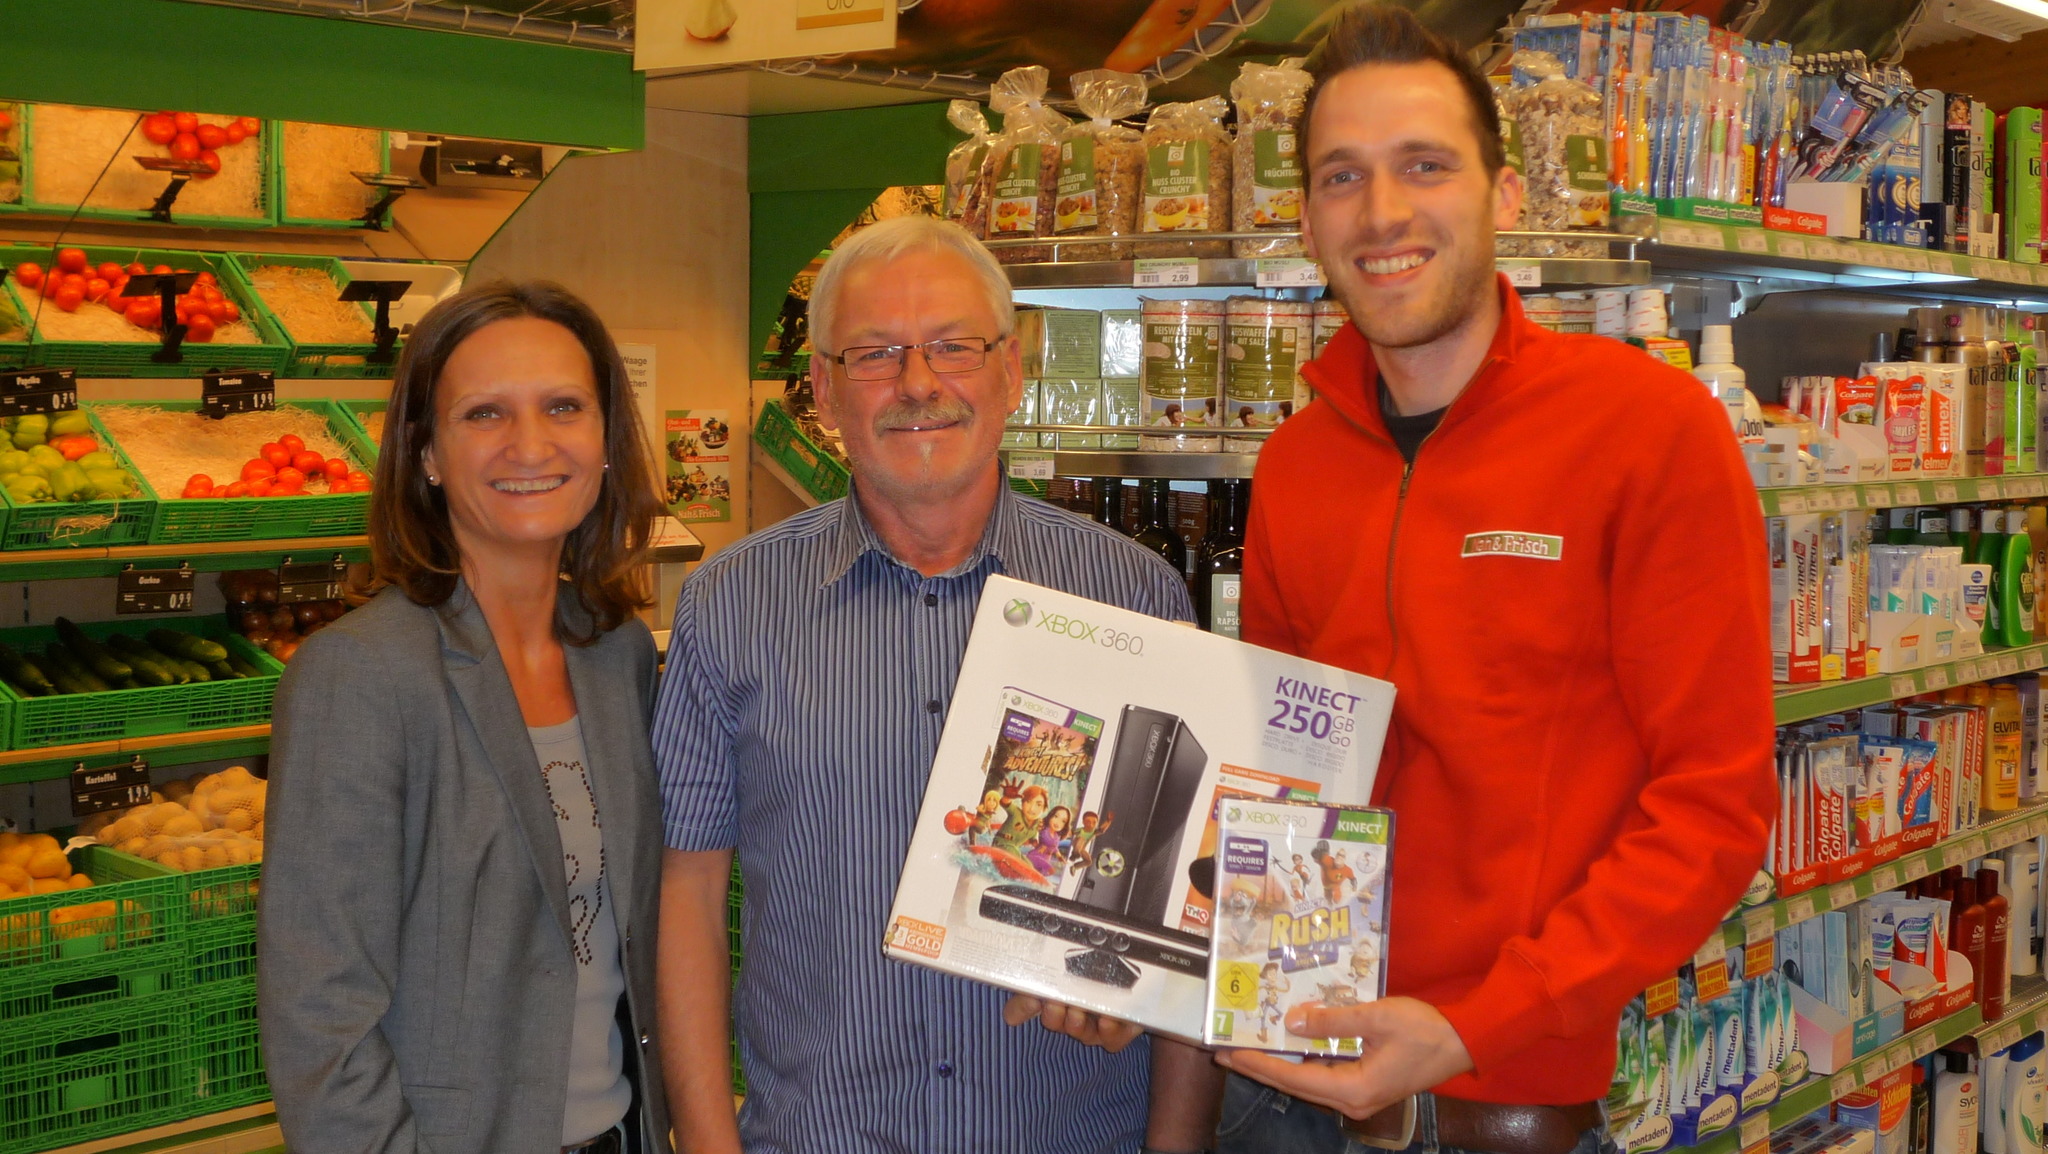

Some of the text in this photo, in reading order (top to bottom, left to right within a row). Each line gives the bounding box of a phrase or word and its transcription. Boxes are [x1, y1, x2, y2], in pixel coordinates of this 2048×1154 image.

[1152, 176, 1197, 187] NUSS CLUSTER
[1159, 185, 1190, 194] CRUNCHY
[1769, 215, 1792, 225] Colgate
[1797, 216, 1824, 230] Colgate
[1172, 274, 1189, 282] 2,99
[1300, 273, 1318, 281] 3,49
[1153, 326, 1203, 336] REISWAFELN
[1839, 391, 1874, 399] Colgate
[1924, 458, 1950, 469] elmex
[1035, 609, 1145, 656] XBOX 360
[1275, 675, 1362, 715] KINECT
[1022, 700, 1044, 715] XBOX
[1073, 717, 1098, 733] KINECT
[1267, 699, 1355, 740] 250 GB
[1006, 724, 1030, 738] REQUIRES
[1003, 754, 1083, 783] ADVENTURES!
[1903, 771, 1931, 815] Colgate
[1941, 771, 1950, 835] Colgate
[1245, 810, 1281, 825] XBOX
[1337, 820, 1383, 835] KINECT
[1818, 799, 1829, 864] Colgate
[1830, 796, 1841, 861] Colgate
[1902, 827, 1934, 842] Colgate
[1874, 841, 1898, 856] Colgate
[1227, 854, 1265, 866] REQUIRES
[1842, 860, 1863, 875] Colgate
[1792, 871, 1816, 885] Colgate
[1748, 883, 1768, 895] tadent
[918, 923, 945, 937] LIVE
[906, 934, 941, 951] GOLD
[1230, 979, 1240, 994] 6
[1946, 989, 1971, 1007] Colgate
[1909, 1001, 1935, 1020] Colgate
[1216, 1014, 1227, 1032] 7
[1723, 1017, 1739, 1075] mentadent
[1701, 1029, 1713, 1089] mentadent
[1654, 1066, 1665, 1117] entadent
[1743, 1080, 1777, 1104] mentadent
[1628, 1122, 1669, 1150] mentadent
